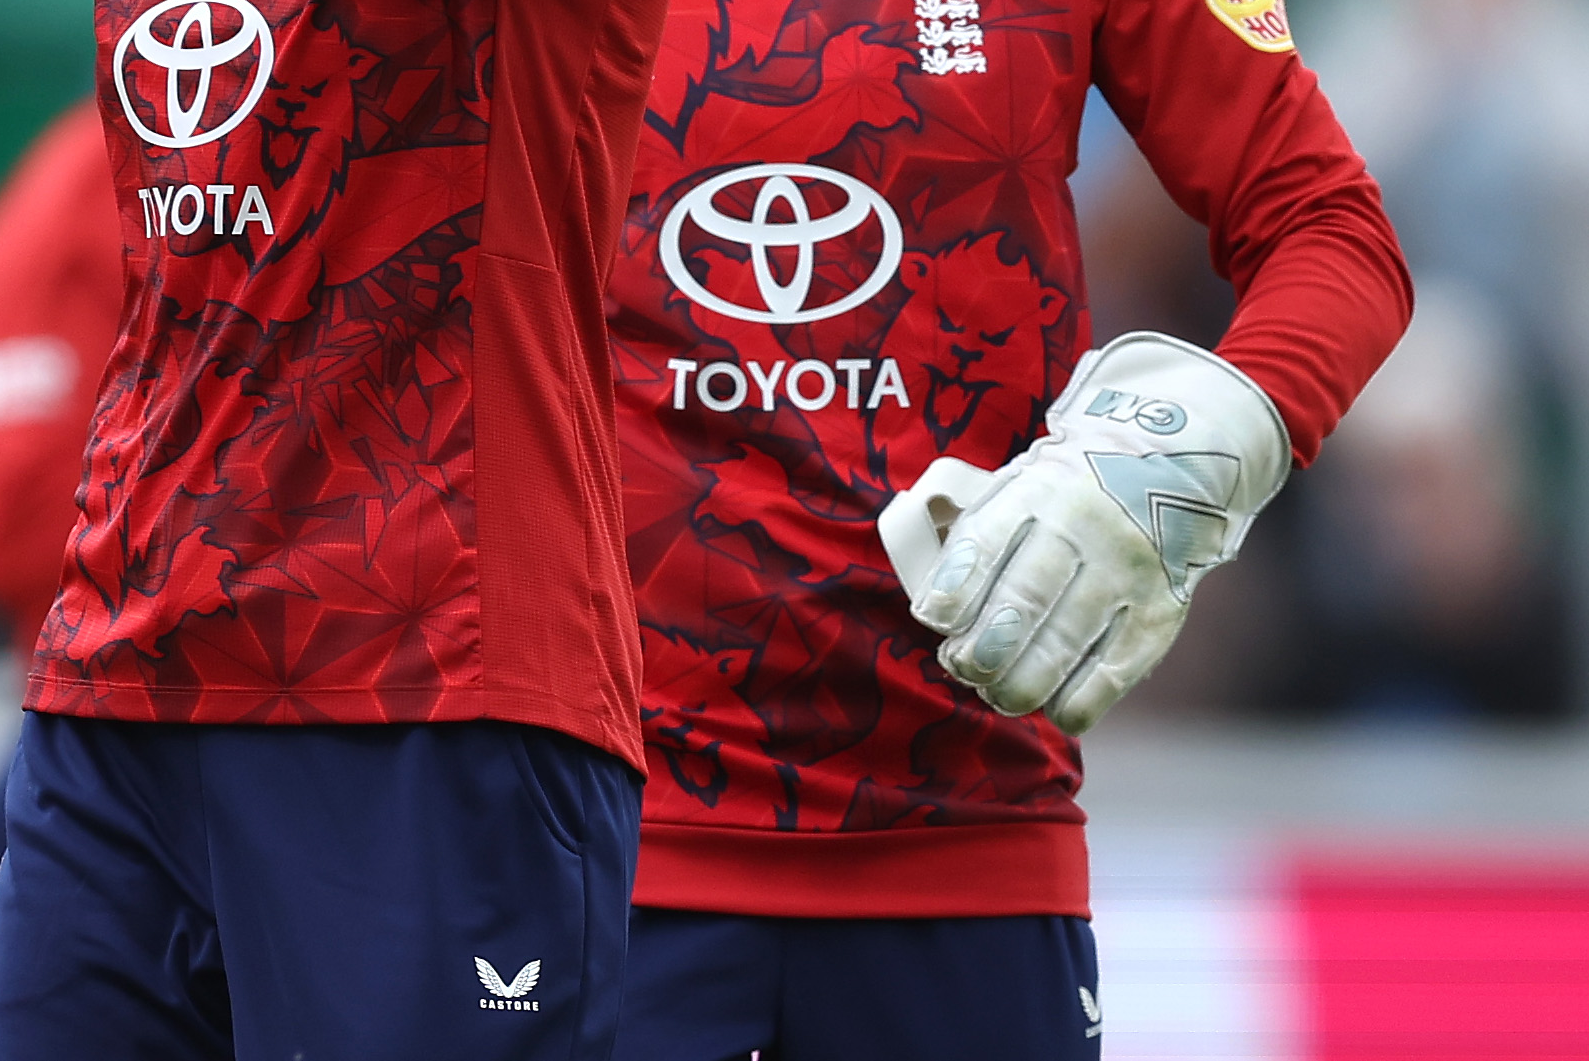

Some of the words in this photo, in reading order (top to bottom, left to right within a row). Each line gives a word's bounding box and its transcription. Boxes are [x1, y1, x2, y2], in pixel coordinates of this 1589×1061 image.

[138, 184, 275, 239] TYOTA
[667, 357, 910, 412] TOYOTA
[479, 998, 540, 1012] CASTORE
